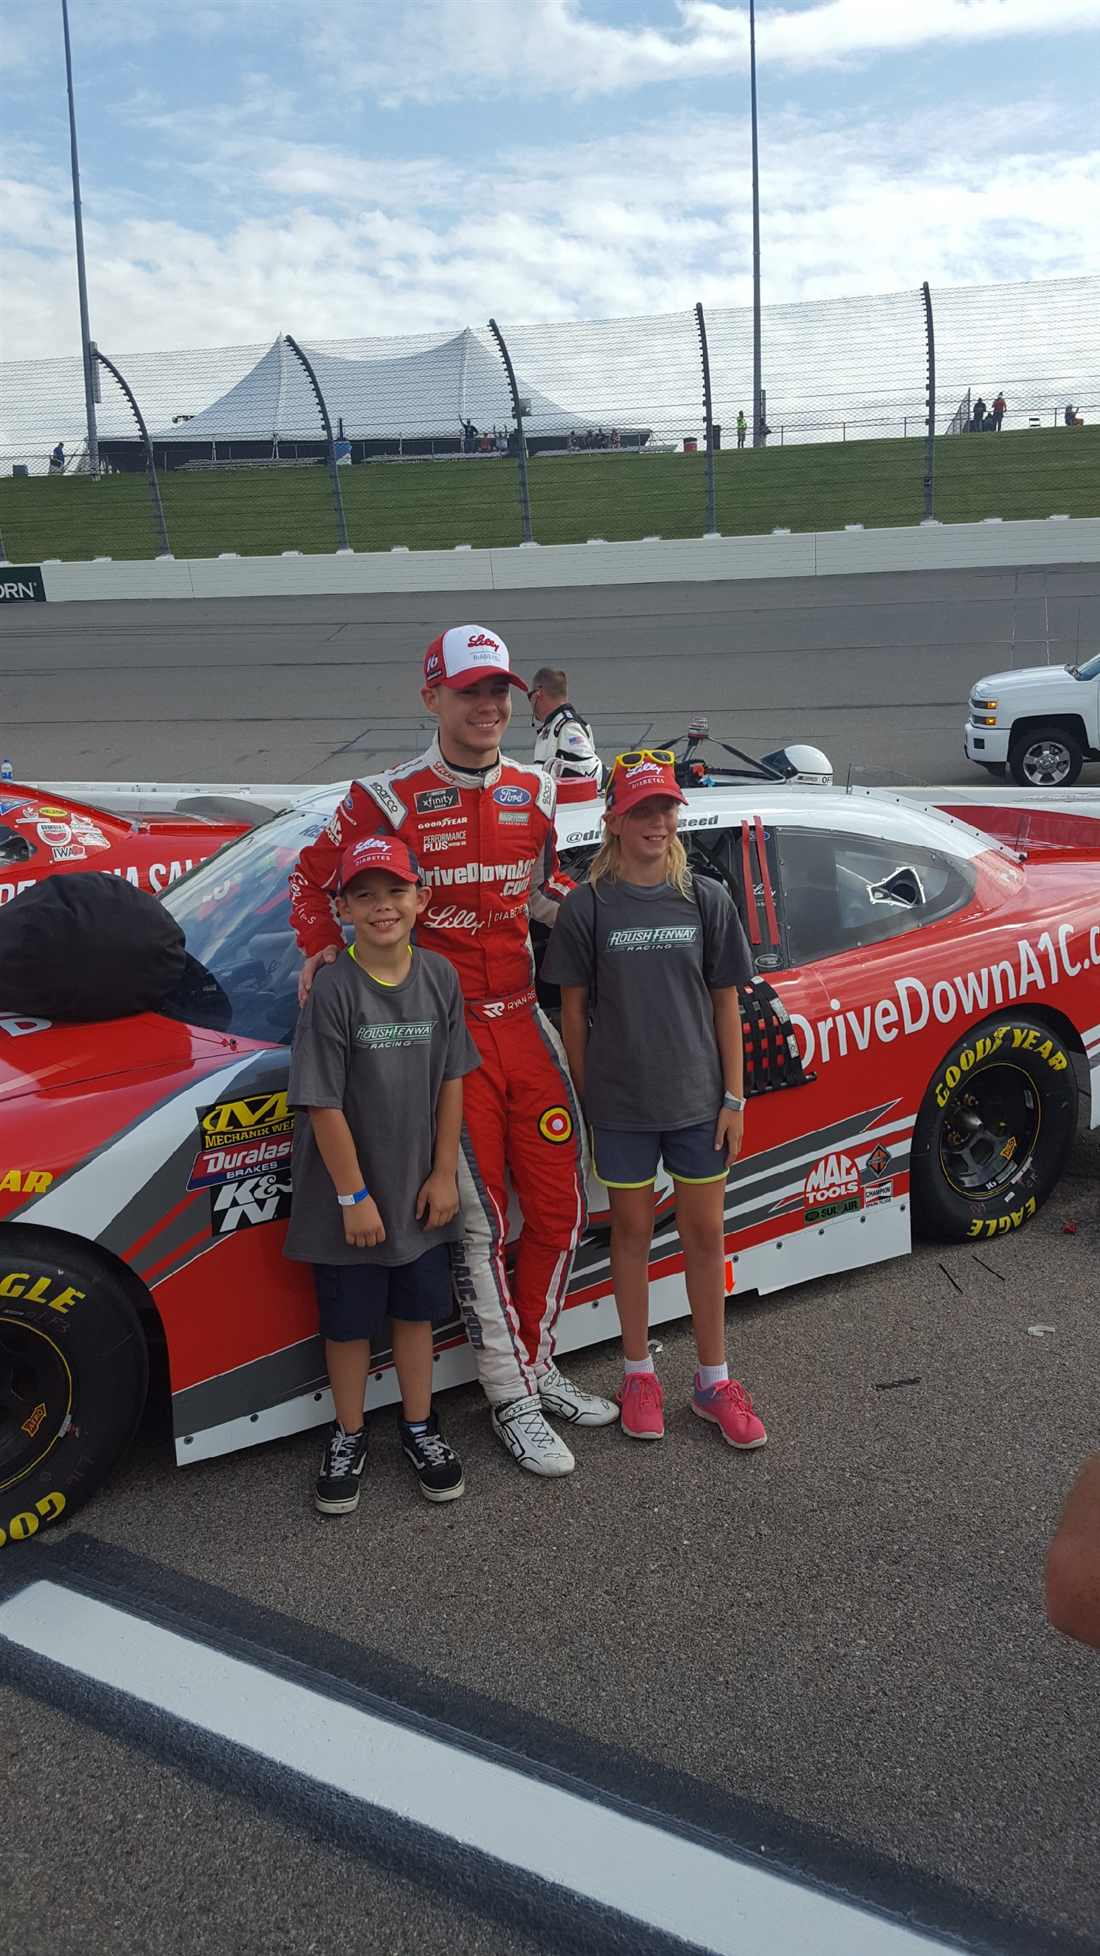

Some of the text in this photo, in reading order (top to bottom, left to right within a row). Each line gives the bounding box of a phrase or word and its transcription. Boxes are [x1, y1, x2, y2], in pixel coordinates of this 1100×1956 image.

[369, 782, 399, 814] sparco
[422, 793, 455, 808] xfinity
[499, 788, 524, 803] Ford
[417, 816, 468, 830] GOODYEAR
[423, 830, 467, 845] PERFORMANCE
[423, 841, 449, 853] PLUS
[424, 904, 486, 936] Lilly
[369, 1040, 413, 1050] RACING
[935, 1025, 1068, 1108] GOODYEAR
[205, 1127, 271, 1149] MECHANIX
[226, 1160, 278, 1180] BRAKES
[806, 1153, 859, 1193] MAC
[806, 1181, 860, 1204] TOOLS
[966, 1195, 1037, 1238] EAGLE
